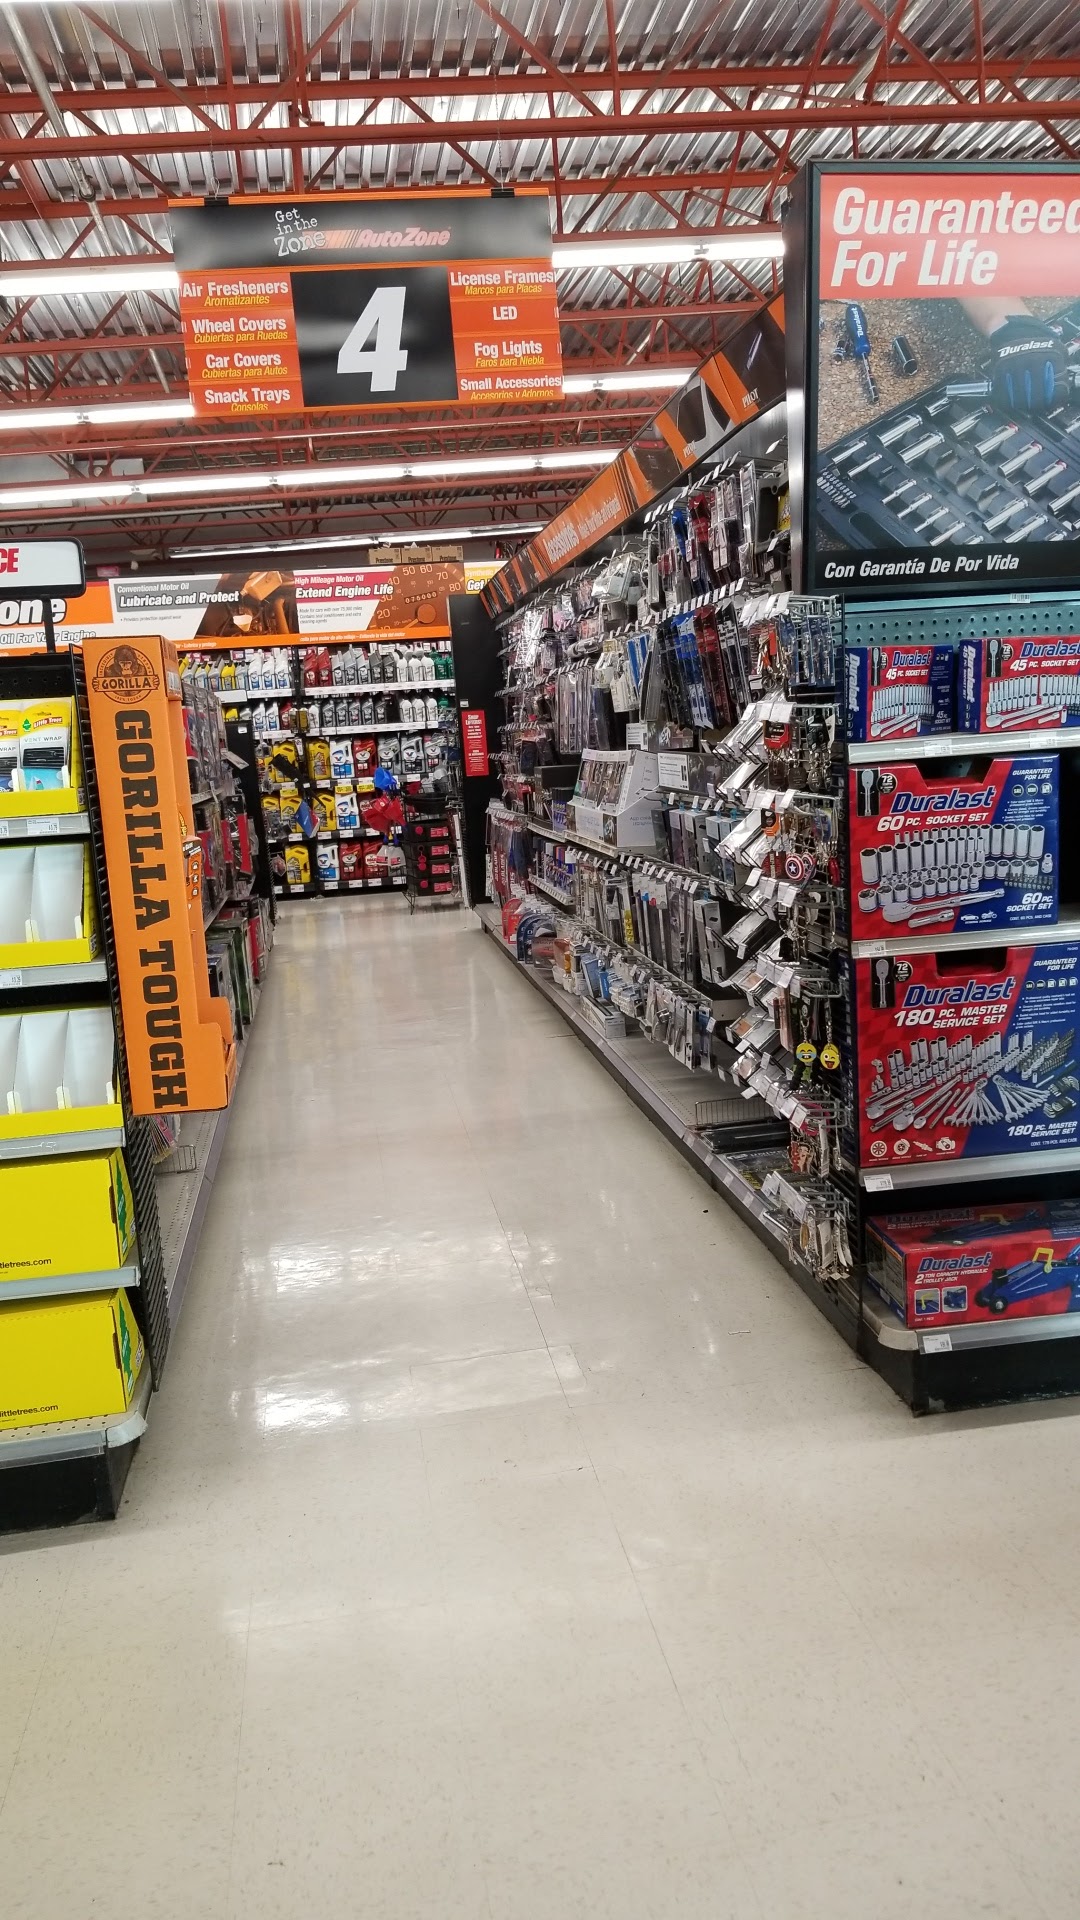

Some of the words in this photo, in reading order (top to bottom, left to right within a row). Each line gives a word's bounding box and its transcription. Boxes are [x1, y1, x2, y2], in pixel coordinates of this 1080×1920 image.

[275, 208, 300, 223] Get
[276, 223, 293, 236] in
[294, 217, 318, 232] the
[274, 231, 326, 257] Zone
[355, 228, 450, 248] AutoZone
[830, 240, 907, 287] For
[917, 239, 998, 286] Life
[450, 272, 500, 286] License
[504, 270, 552, 285] Frames
[183, 282, 203, 298] Air
[207, 281, 289, 297] Fresheners
[464, 285, 494, 295] Marcos
[496, 285, 514, 295] para
[516, 283, 543, 294] Placas
[204, 295, 270, 307] Aromatizantes
[492, 305, 518, 320] LED
[191, 318, 235, 334] Wheel
[239, 317, 287, 331] Covers
[850, 307, 864, 338] Duralast
[194, 332, 234, 343] Cubiertas
[236, 333, 255, 343] para
[257, 331, 288, 340] Ruedas
[336, 286, 408, 392] 4
[474, 342, 499, 358] Fog
[502, 340, 543, 357] Lights
[998, 340, 1054, 358] Duralast
[205, 354, 230, 369] Car
[233, 353, 282, 367] Covers
[475, 357, 498, 368] Faros
[500, 357, 517, 366] para
[519, 355, 545, 366] Niebla
[202, 368, 242, 379] Cubiertas
[243, 367, 262, 378] para
[264, 366, 288, 376] Autos
[460, 378, 492, 391] Small
[495, 375, 561, 390] Accessories
[204, 389, 250, 404] Snack
[251, 387, 291, 404] Trays
[470, 389, 513, 400] Accesorios
[521, 389, 554, 398] Adornos
[741, 388, 759, 408] PILOT
[231, 402, 269, 412] Consolas
[402, 566, 416, 576] 50
[420, 564, 432, 573] 60
[824, 562, 855, 579] Con
[859, 558, 925, 576] Garantía
[929, 557, 951, 573] De
[954, 556, 982, 572] Por
[986, 554, 1020, 571] Vida
[294, 577, 310, 585] High
[310, 576, 335, 584] Mileage
[436, 571, 448, 580] 70
[117, 584, 159, 594] Conventional
[160, 583, 179, 592] Motor
[295, 586, 333, 599] Extend
[335, 585, 371, 598] Engine
[373, 584, 394, 595] Life
[449, 582, 461, 592] 80
[467, 580, 485, 591] Get
[120, 594, 173, 608] Lubricate
[175, 593, 197, 605] and
[198, 591, 240, 604] Protect
[376, 609, 390, 619] 20
[0, 633, 14, 644] Oil
[16, 634, 34, 644] For
[36, 632, 60, 643] Yor
[892, 650, 931, 667] Duralast
[1010, 659, 1028, 671] 45
[1066, 658, 1080, 666] SET
[886, 668, 897, 680] 45
[966, 645, 976, 703] Duralast
[101, 678, 151, 690] GORILLA
[848, 653, 860, 712] Duralast
[33, 718, 47, 728] Little
[882, 775, 893, 783] 72
[1012, 768, 1053, 776] GUARANTEED
[889, 785, 997, 815] Duralast
[114, 709, 170, 931] GORILLA
[877, 815, 905, 831] 60
[905, 817, 921, 826] PC.
[926, 814, 967, 825] SOCKET
[968, 812, 989, 822] SET
[1021, 892, 1042, 904] 60
[1006, 903, 1037, 912] SOCKET
[896, 963, 908, 971] 72
[1033, 957, 1077, 967] GUARANTEED
[901, 976, 1016, 1008] Duralast
[894, 1008, 935, 1027] 180
[939, 1008, 956, 1018] PC.
[960, 1004, 1007, 1017] MASTER
[932, 1016, 980, 1029] SERVICE
[982, 1014, 1004, 1025] SET
[139, 941, 189, 1109] TOUGH
[1007, 1125, 1033, 1136] 180
[1048, 1121, 1078, 1130] MASTER
[1031, 1129, 1061, 1138] SERVICE
[918, 1252, 993, 1273] Duralast
[914, 1274, 924, 1284] 2
